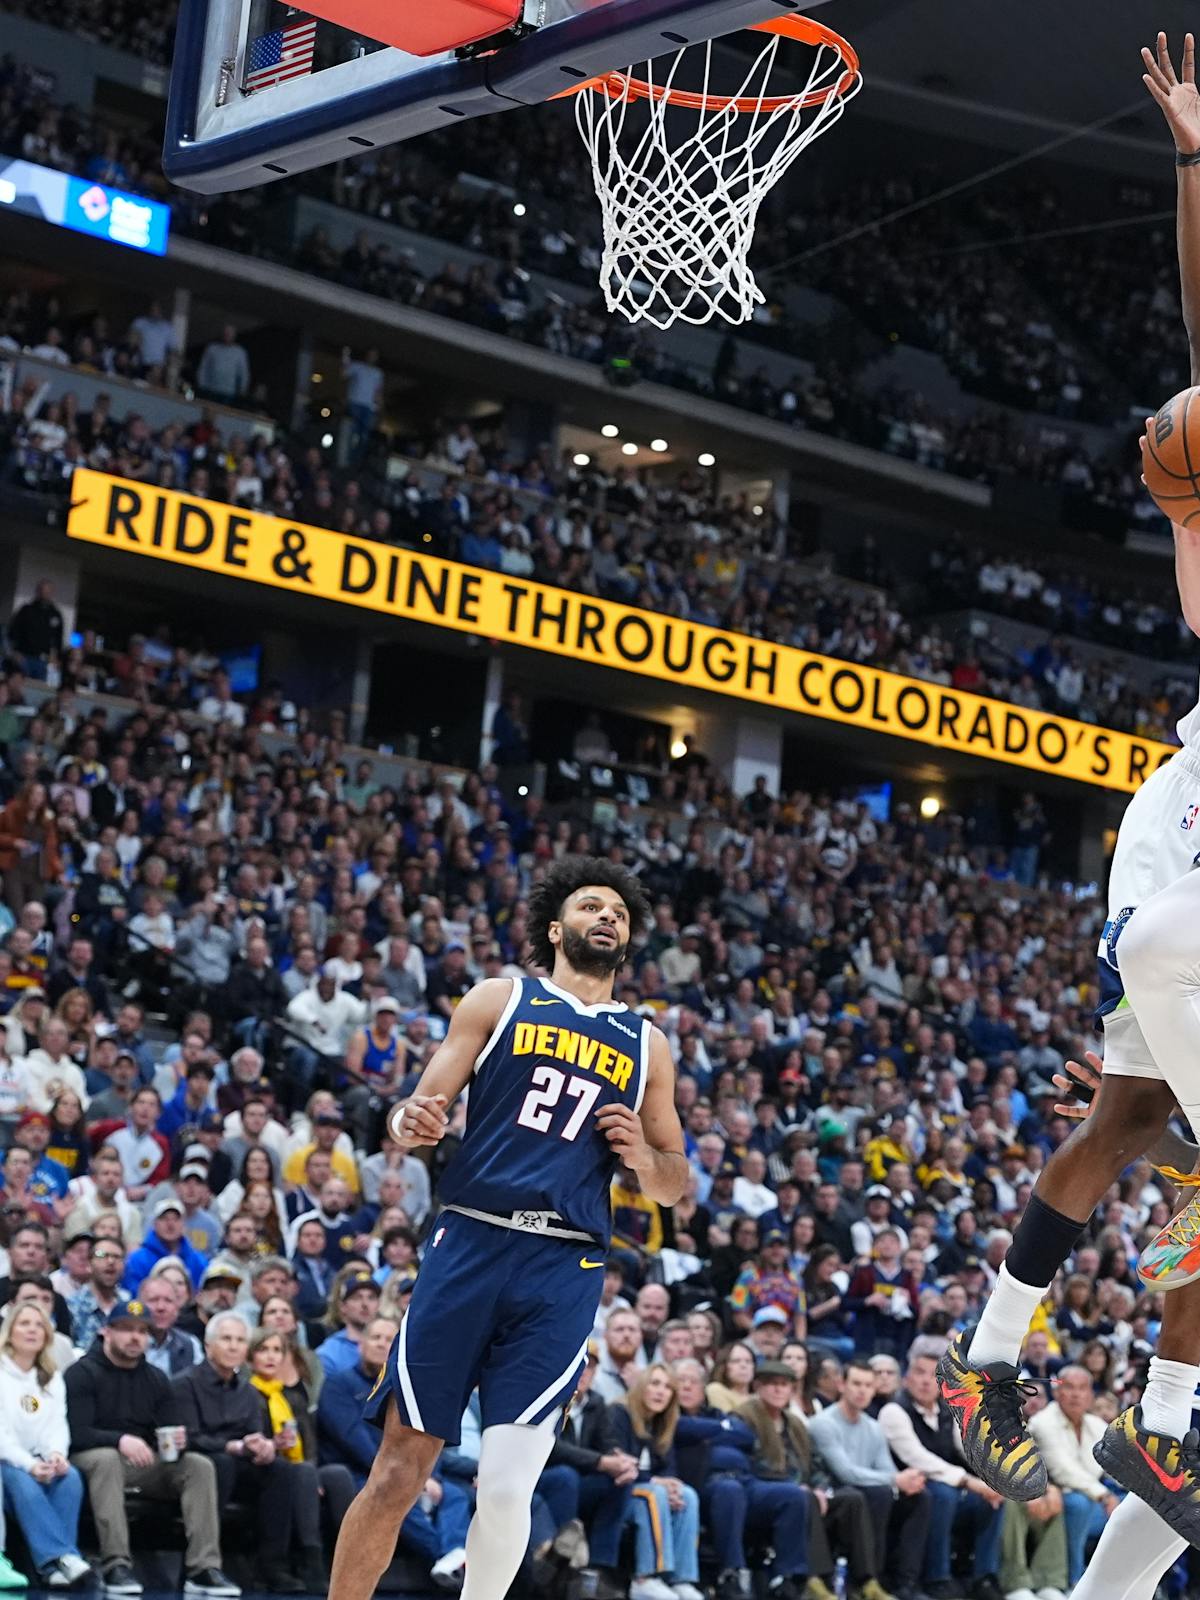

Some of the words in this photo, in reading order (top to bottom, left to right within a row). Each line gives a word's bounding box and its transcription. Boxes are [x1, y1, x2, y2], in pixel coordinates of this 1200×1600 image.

[105, 484, 252, 568] RIDE
[272, 528, 312, 584] &
[341, 543, 482, 623] DINE
[503, 583, 778, 695] THROUGH
[797, 660, 1111, 777] COLORADO'S
[512, 1022, 635, 1092] DENVER
[517, 1066, 602, 1142] 27
